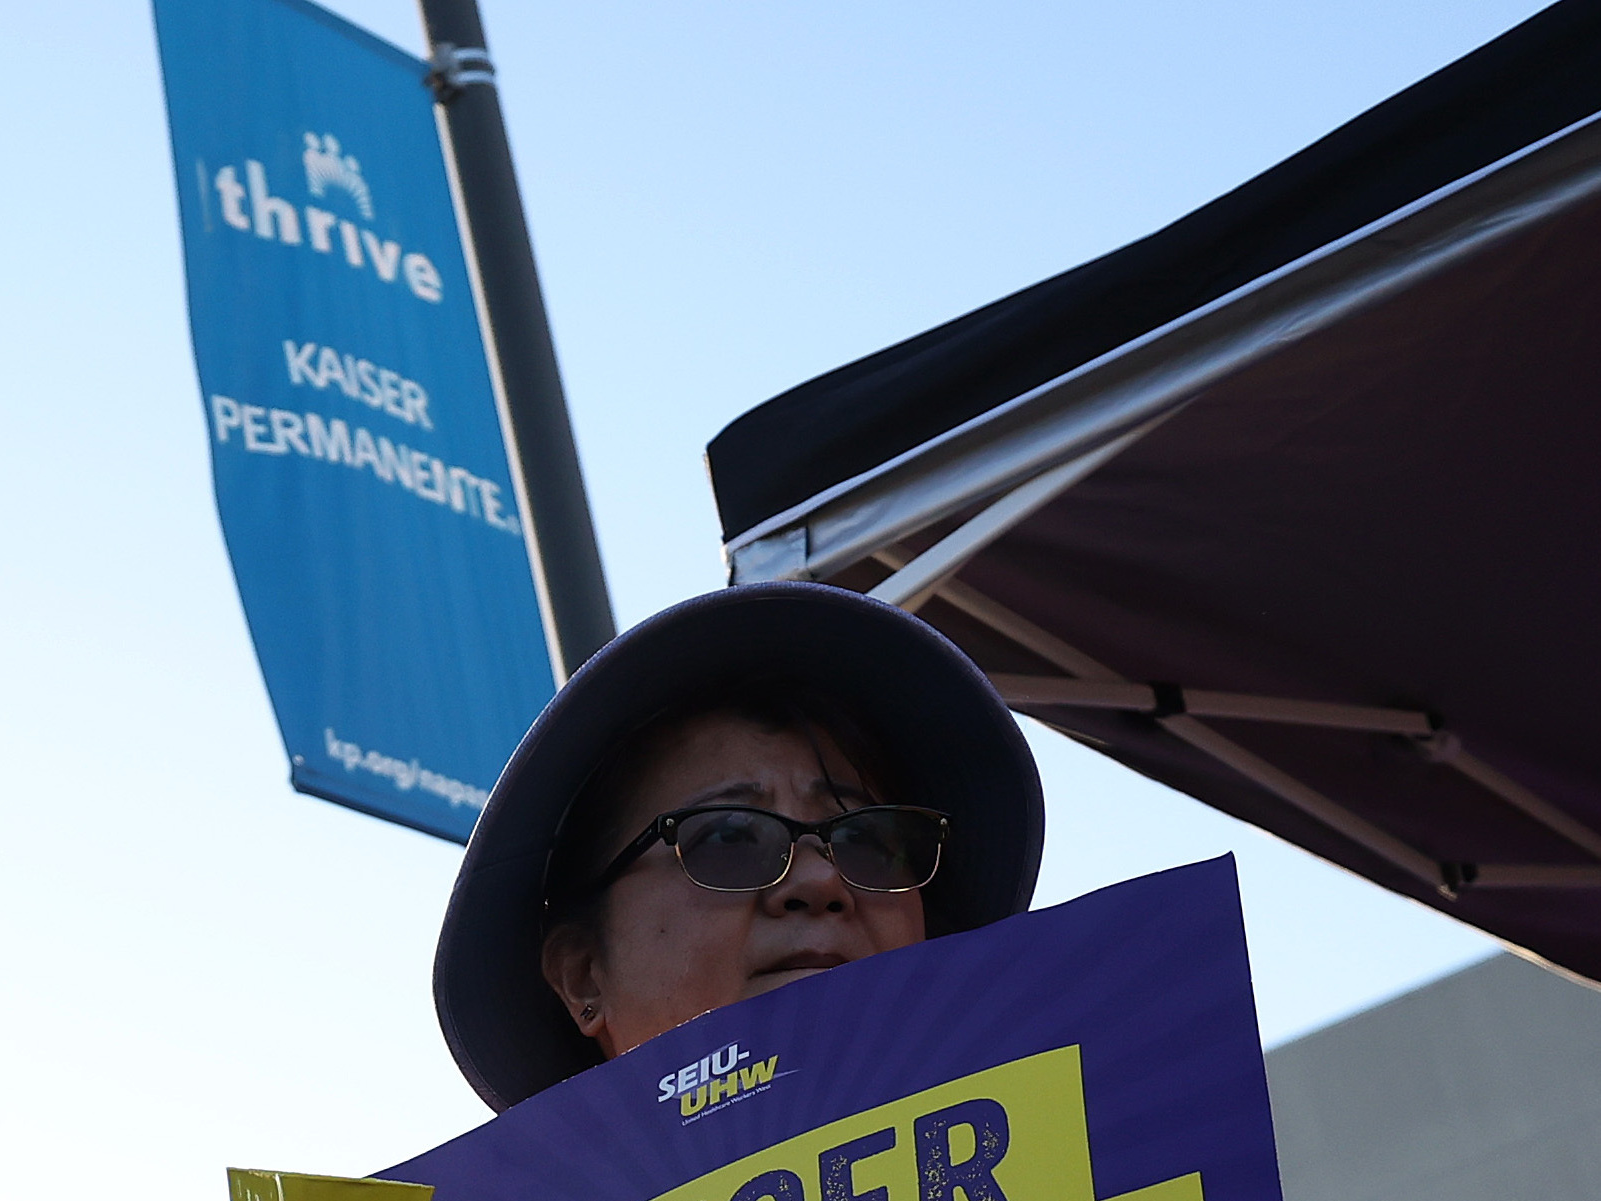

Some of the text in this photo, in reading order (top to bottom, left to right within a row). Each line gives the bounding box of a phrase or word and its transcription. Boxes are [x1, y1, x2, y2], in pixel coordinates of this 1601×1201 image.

[214, 159, 444, 304] thrive
[282, 339, 435, 431] KAISER
[210, 394, 512, 529] PERMANENTE
[658, 1043, 750, 1103] SEIU-
[680, 1054, 779, 1117] UHW
